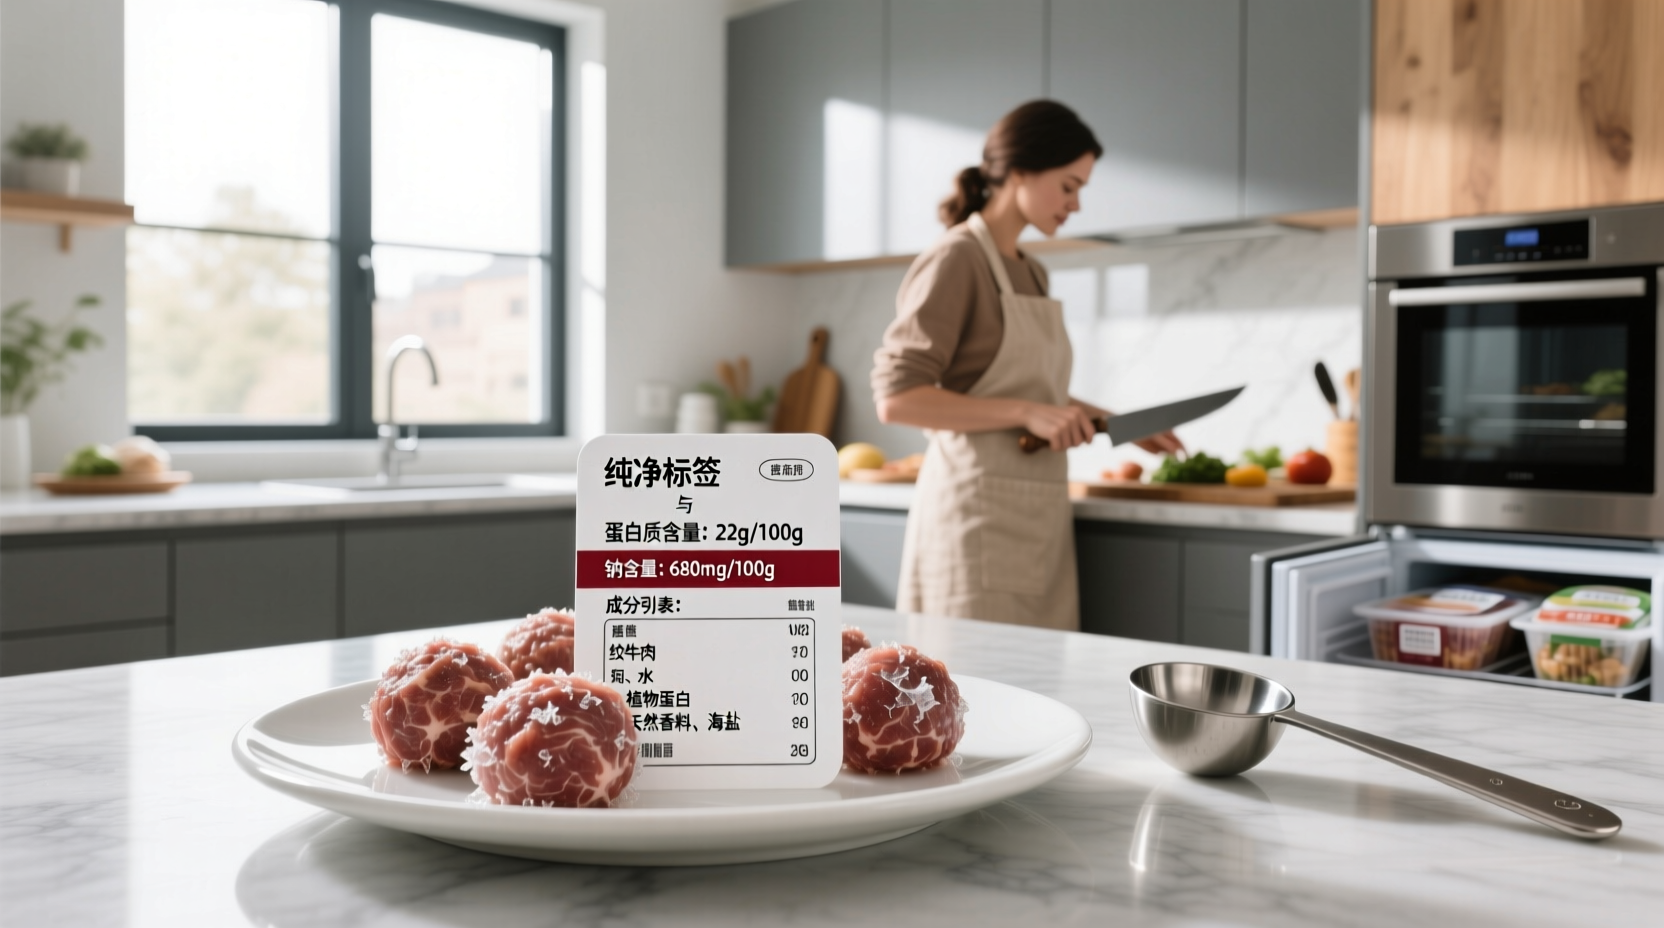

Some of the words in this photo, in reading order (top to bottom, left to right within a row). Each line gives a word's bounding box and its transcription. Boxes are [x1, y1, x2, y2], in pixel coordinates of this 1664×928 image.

[604, 456, 721, 489] 纯净标签
[676, 495, 693, 514] 与
[715, 522, 803, 546] 22g/100g
[669, 559, 775, 582] 680mg/100g
[626, 690, 690, 708] 植物蛋白
